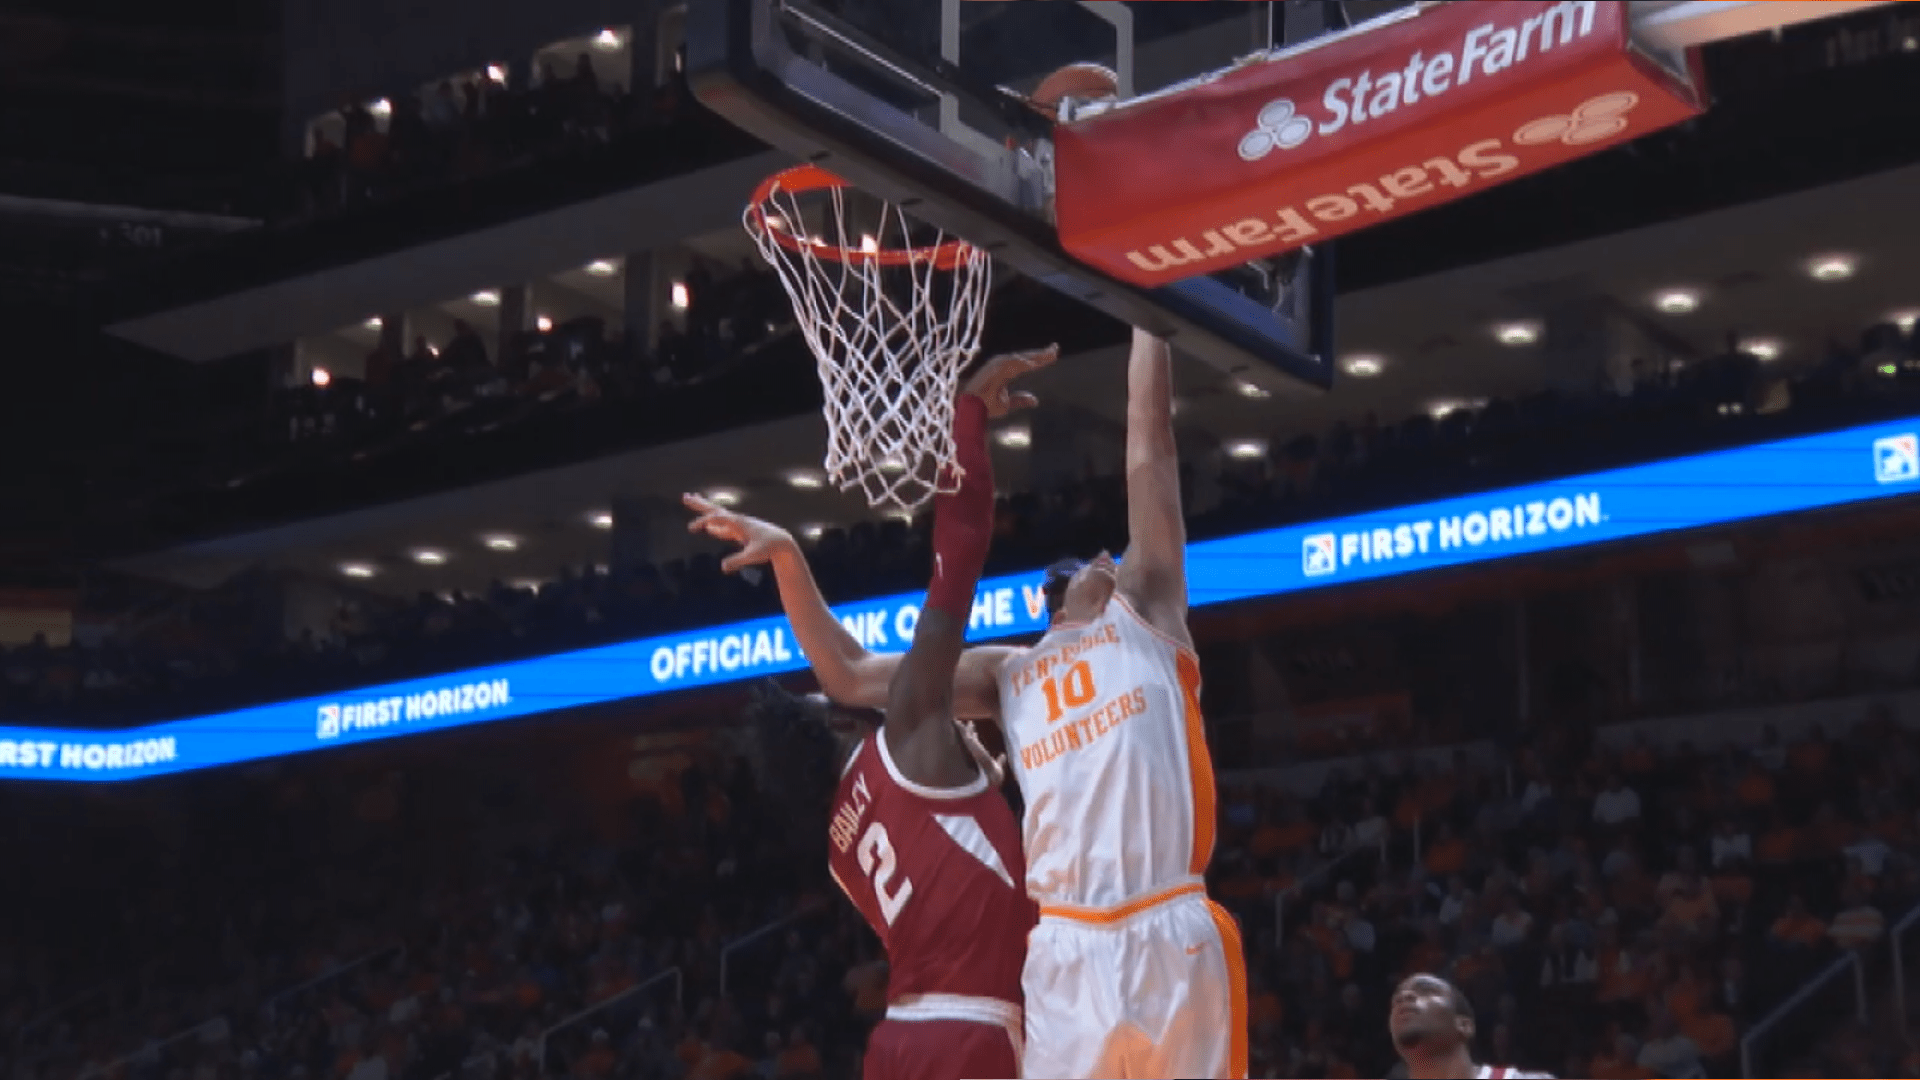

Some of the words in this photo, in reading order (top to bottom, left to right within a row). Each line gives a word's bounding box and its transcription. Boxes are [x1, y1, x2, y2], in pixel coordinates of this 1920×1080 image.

[1340, 520, 1433, 566] FIRST
[1438, 491, 1601, 551] HORIZON
[650, 626, 793, 683] OFFICIAL
[969, 587, 1015, 629] HE
[341, 695, 404, 732] FIRST
[405, 677, 510, 722] HORIZON
[1020, 686, 1148, 770] VOLUNTEERS
[1040, 659, 1097, 726] 10
[0, 738, 58, 769] RST
[59, 733, 178, 770] HORIZON
[857, 821, 914, 928] 2
